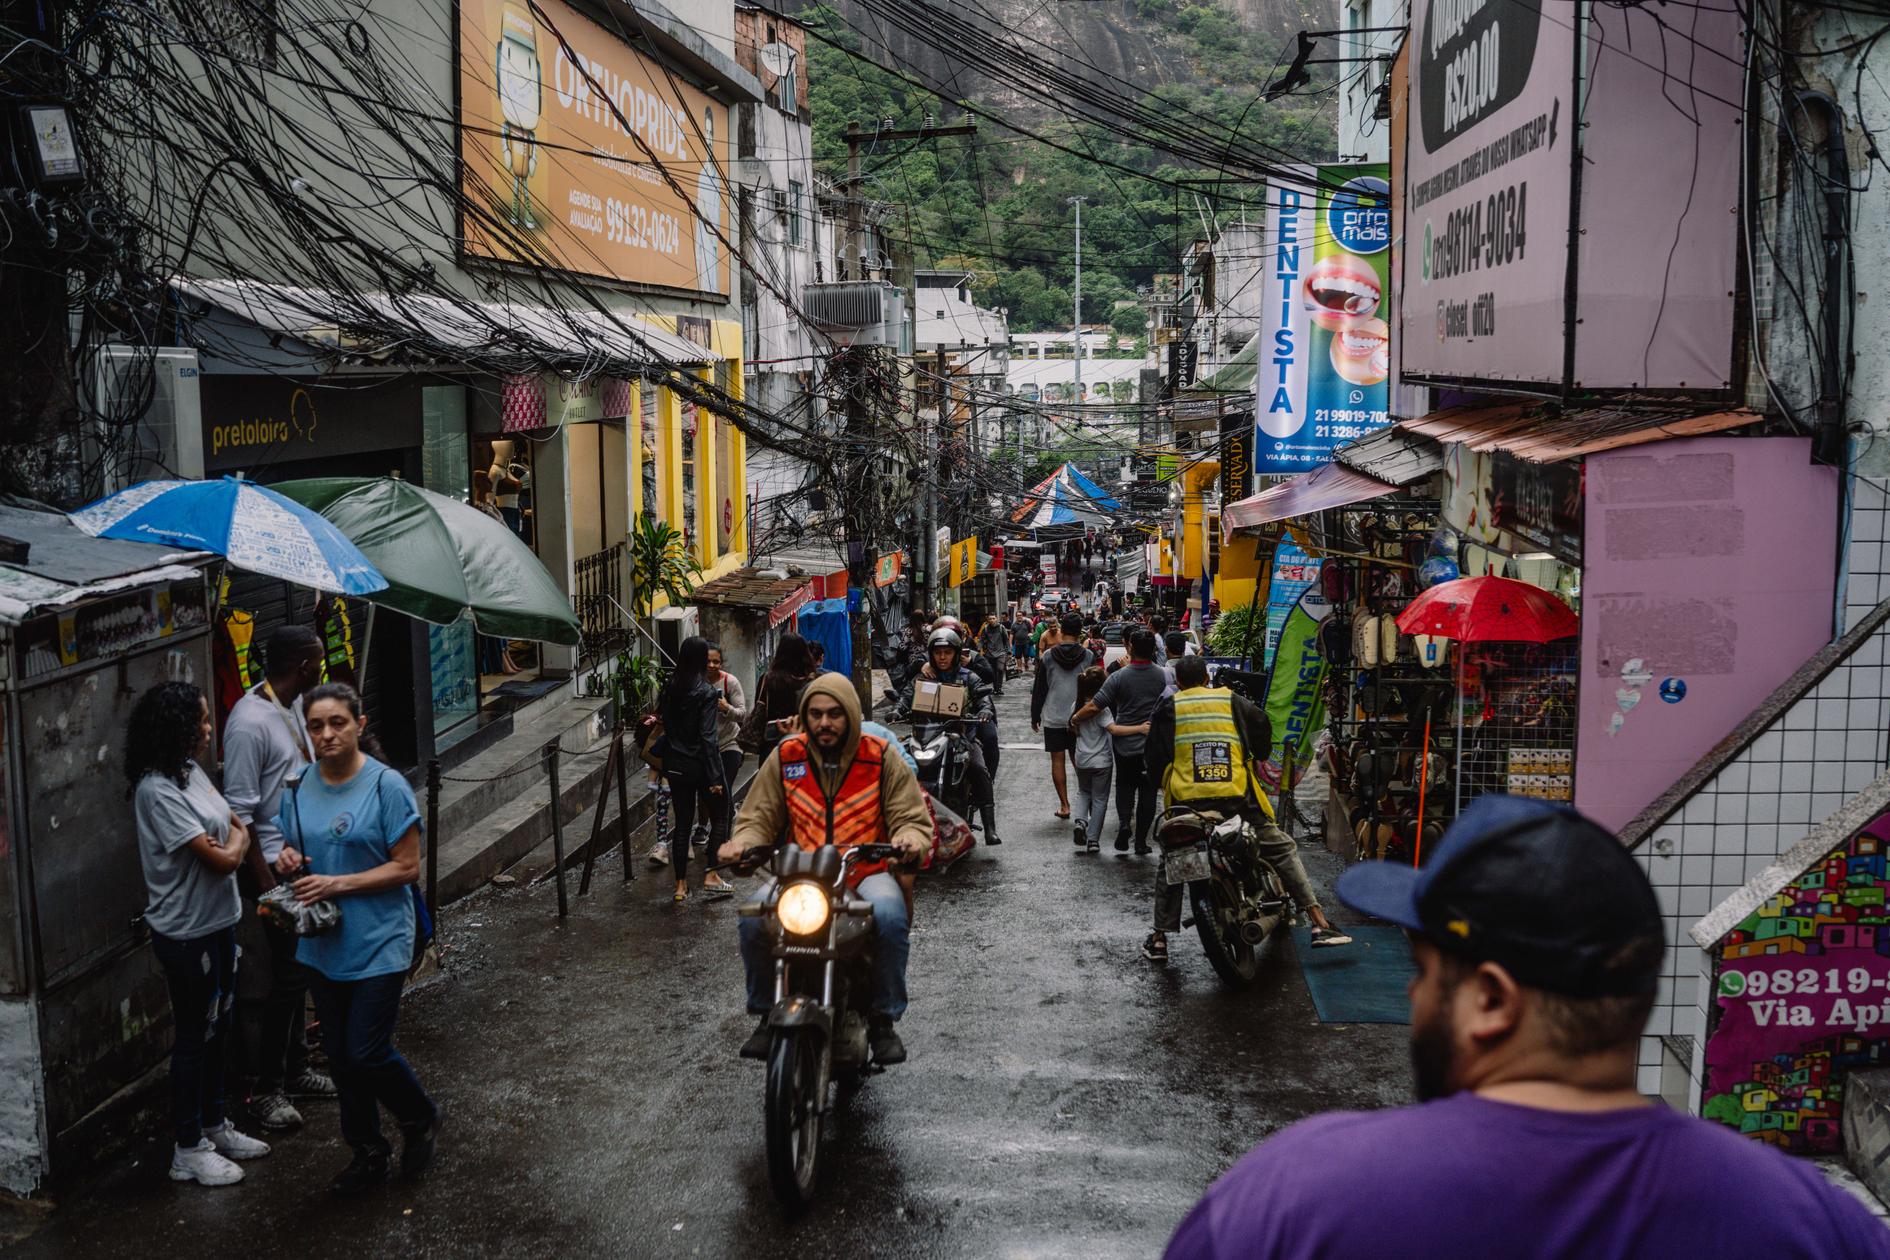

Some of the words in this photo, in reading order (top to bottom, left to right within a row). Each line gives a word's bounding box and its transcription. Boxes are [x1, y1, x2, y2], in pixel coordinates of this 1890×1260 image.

[1443, 20, 1500, 133] R$20,00
[554, 45, 687, 162] ORTHOPRIDE
[1490, 133, 1509, 171] NOSSO
[1509, 112, 1547, 161] WHATSAPP
[568, 189, 591, 208] AGENDE
[591, 195, 602, 213] SUA
[606, 196, 680, 255] 99132-0624
[1342, 209, 1388, 226] orto
[1342, 225, 1388, 241] mais
[1269, 189, 1301, 414] DENTISTA
[180, 367, 198, 378] ELGIN
[1315, 409, 1329, 421] 21
[1315, 426, 1329, 438] 21
[1283, 636, 1323, 748] DENTISTA
[1199, 768, 1228, 778] 1350
[1747, 967, 1890, 998] 98219-
[1747, 999, 1815, 1027] Via
